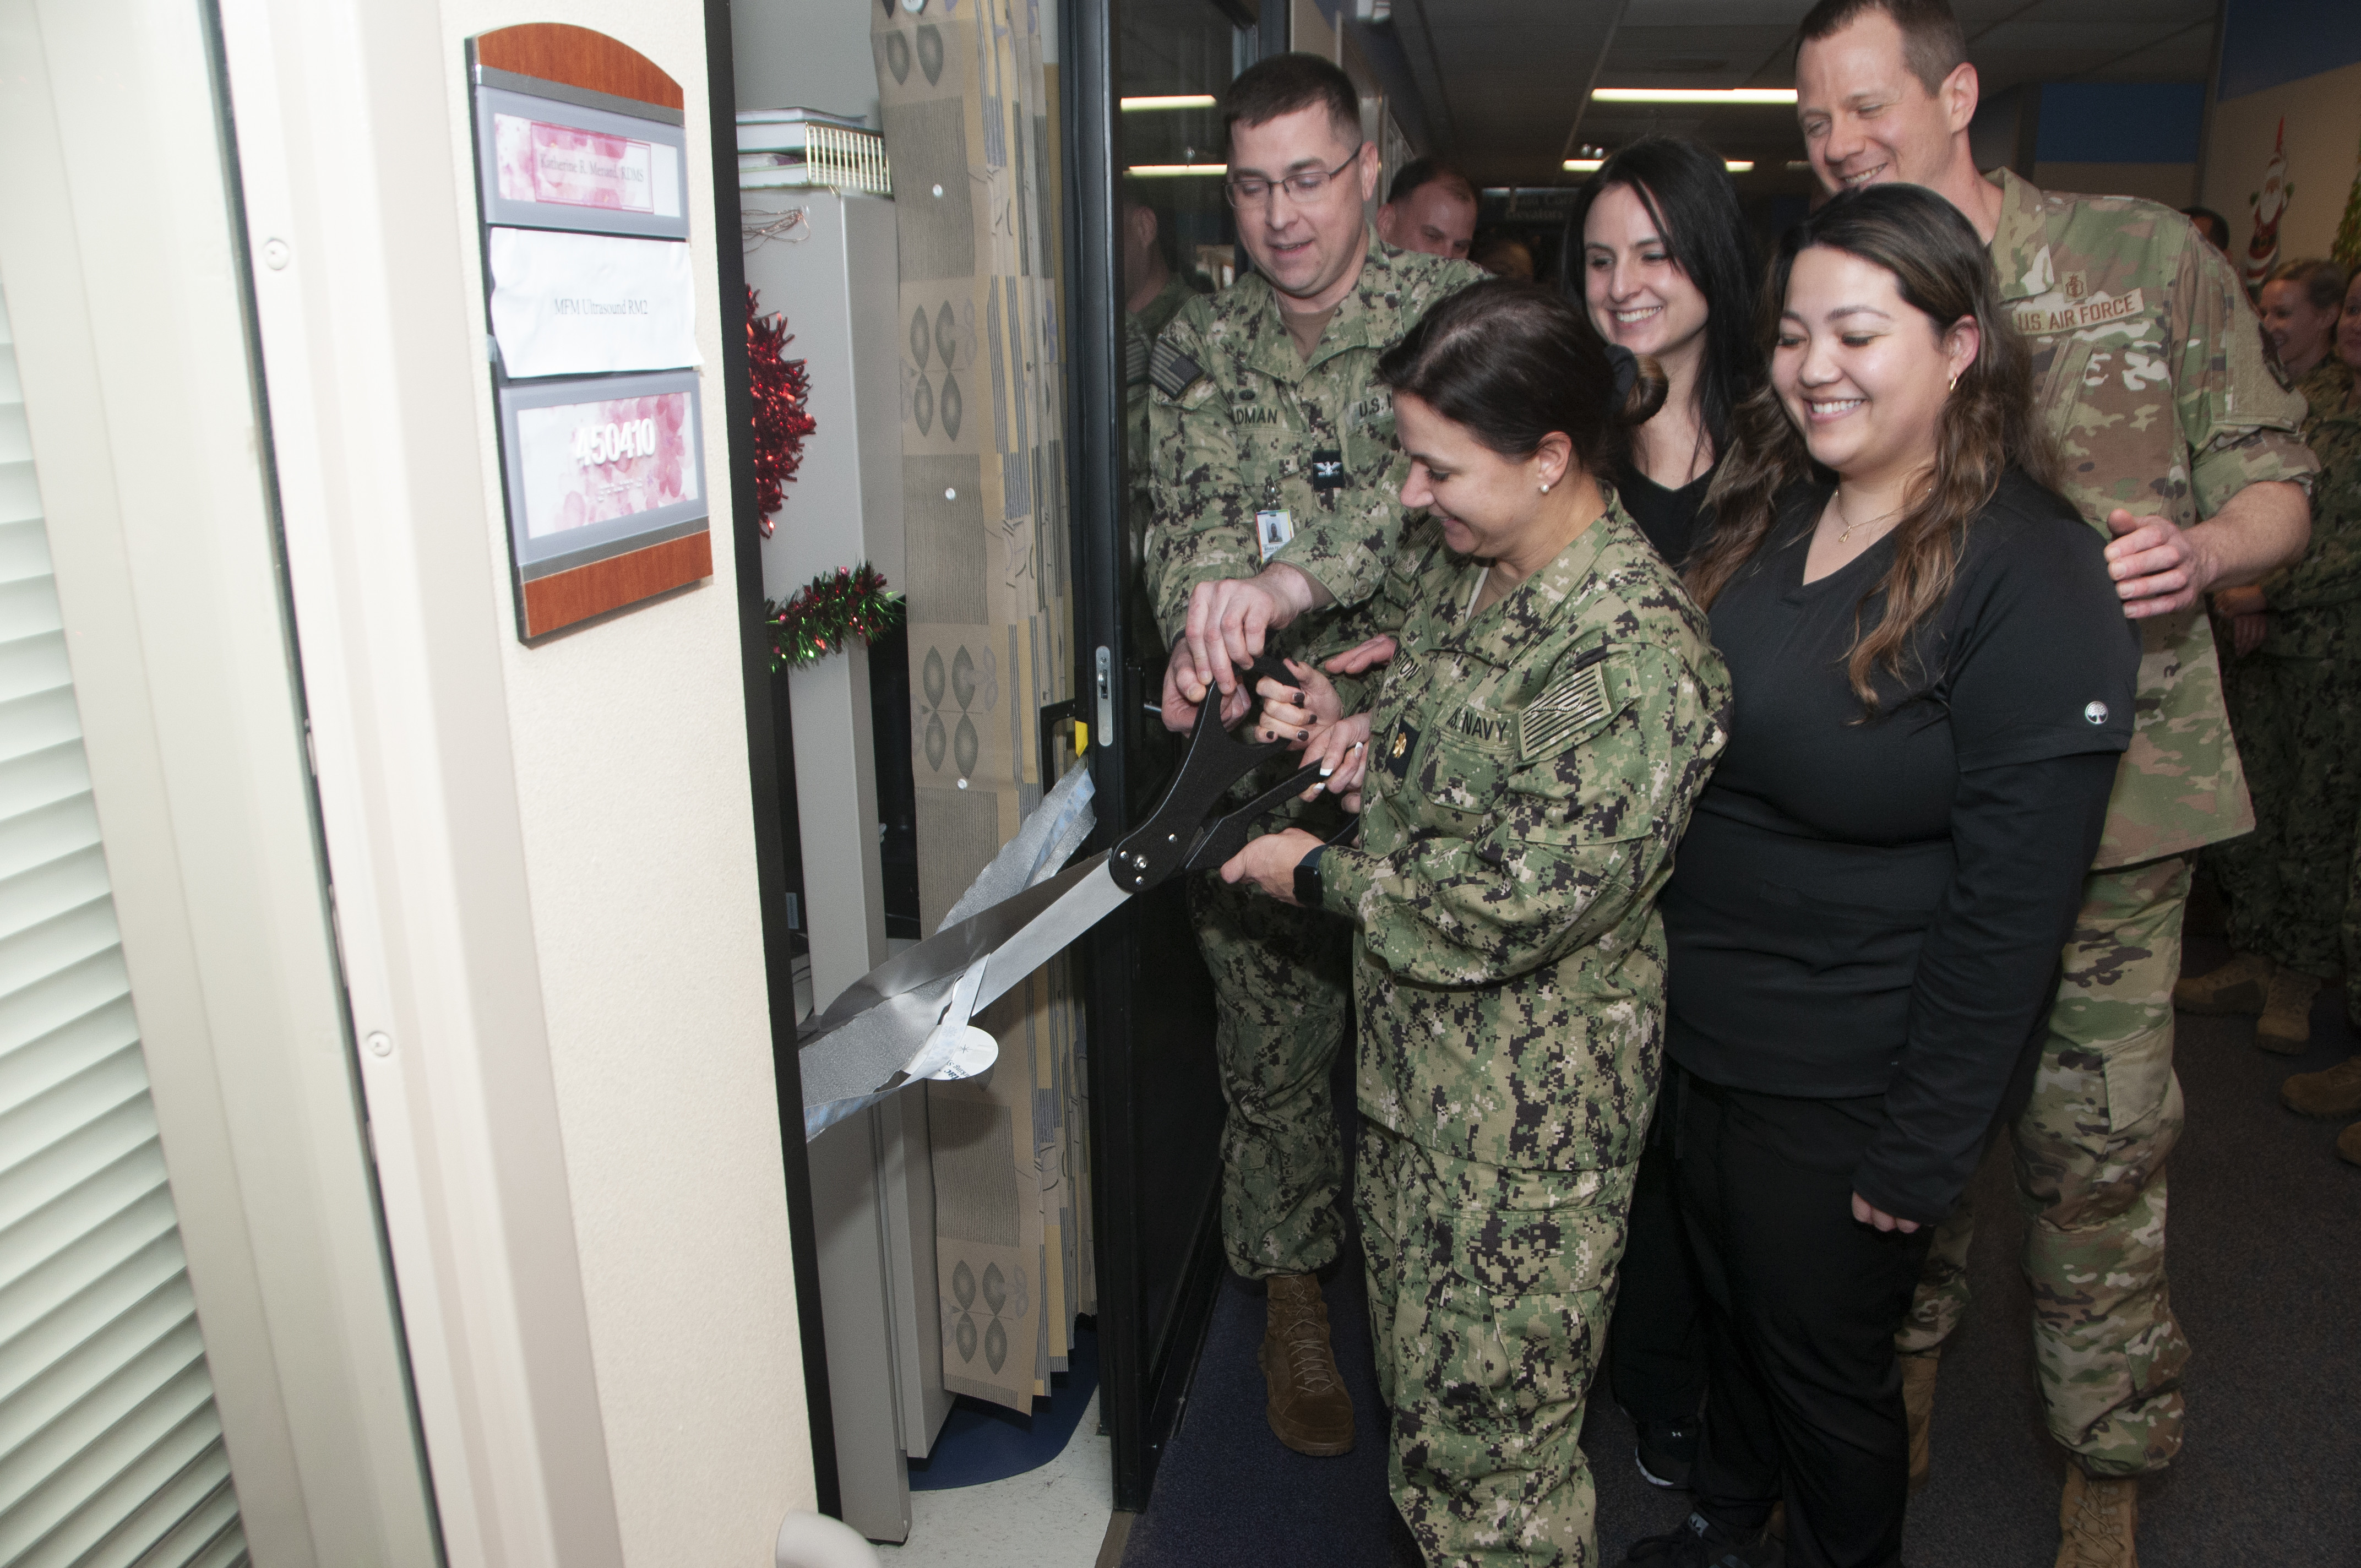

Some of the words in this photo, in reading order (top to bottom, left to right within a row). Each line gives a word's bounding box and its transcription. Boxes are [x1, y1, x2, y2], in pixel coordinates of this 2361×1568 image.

[540, 154, 577, 172] Katherine
[621, 166, 644, 182] RDMS
[554, 298, 580, 314] MFM
[582, 299, 626, 314] Ultrasound
[628, 300, 648, 314] RM2
[2049, 309, 2075, 330] AIR
[2080, 295, 2135, 324] FORCE
[1359, 397, 1384, 417] U.S.
[576, 418, 656, 466] 450410
[1462, 711, 1508, 742] NAVY
